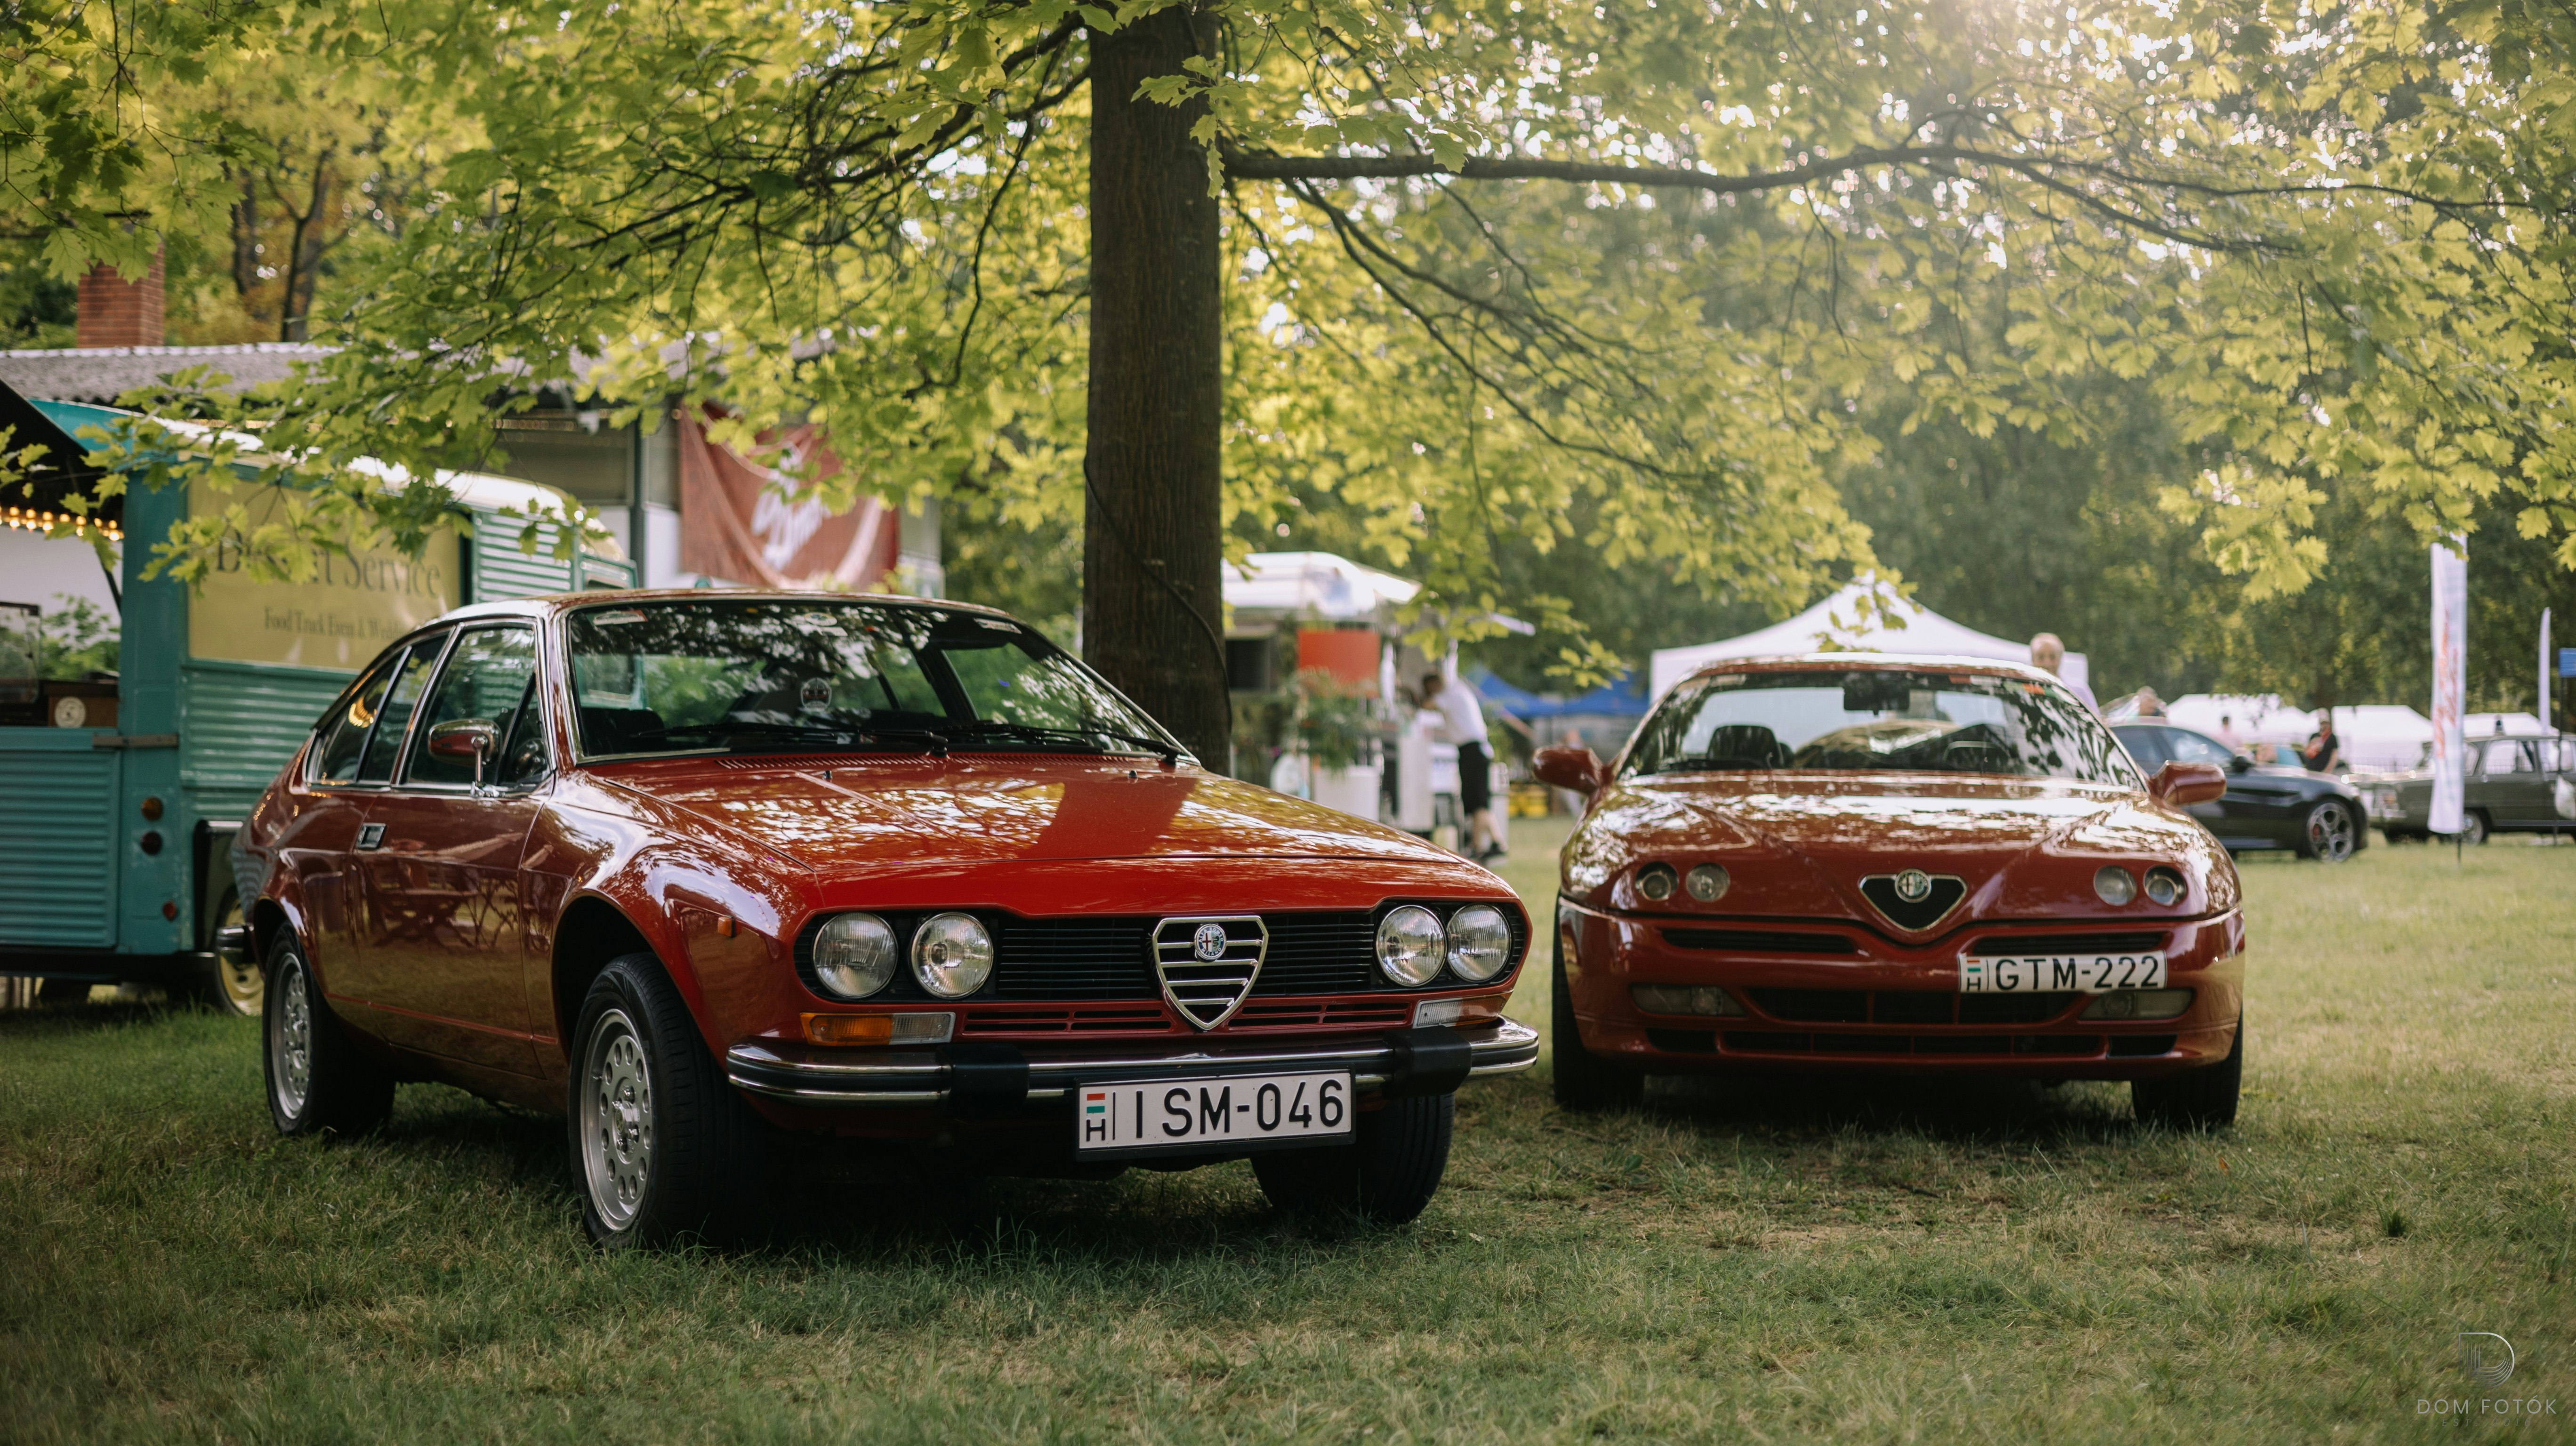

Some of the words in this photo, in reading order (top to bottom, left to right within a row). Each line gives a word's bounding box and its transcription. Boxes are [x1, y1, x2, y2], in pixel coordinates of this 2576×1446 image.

[343, 533, 441, 599] Service
[265, 606, 293, 632] Food
[294, 609, 324, 634] Truck
[1198, 929, 1208, 942] ALFA
[1209, 927, 1224, 941] ROMEO
[1201, 948, 1222, 956] MILANO
[1966, 976, 1981, 992] H
[1996, 956, 2159, 991] GTM-222
[1086, 1118, 1106, 1141] H
